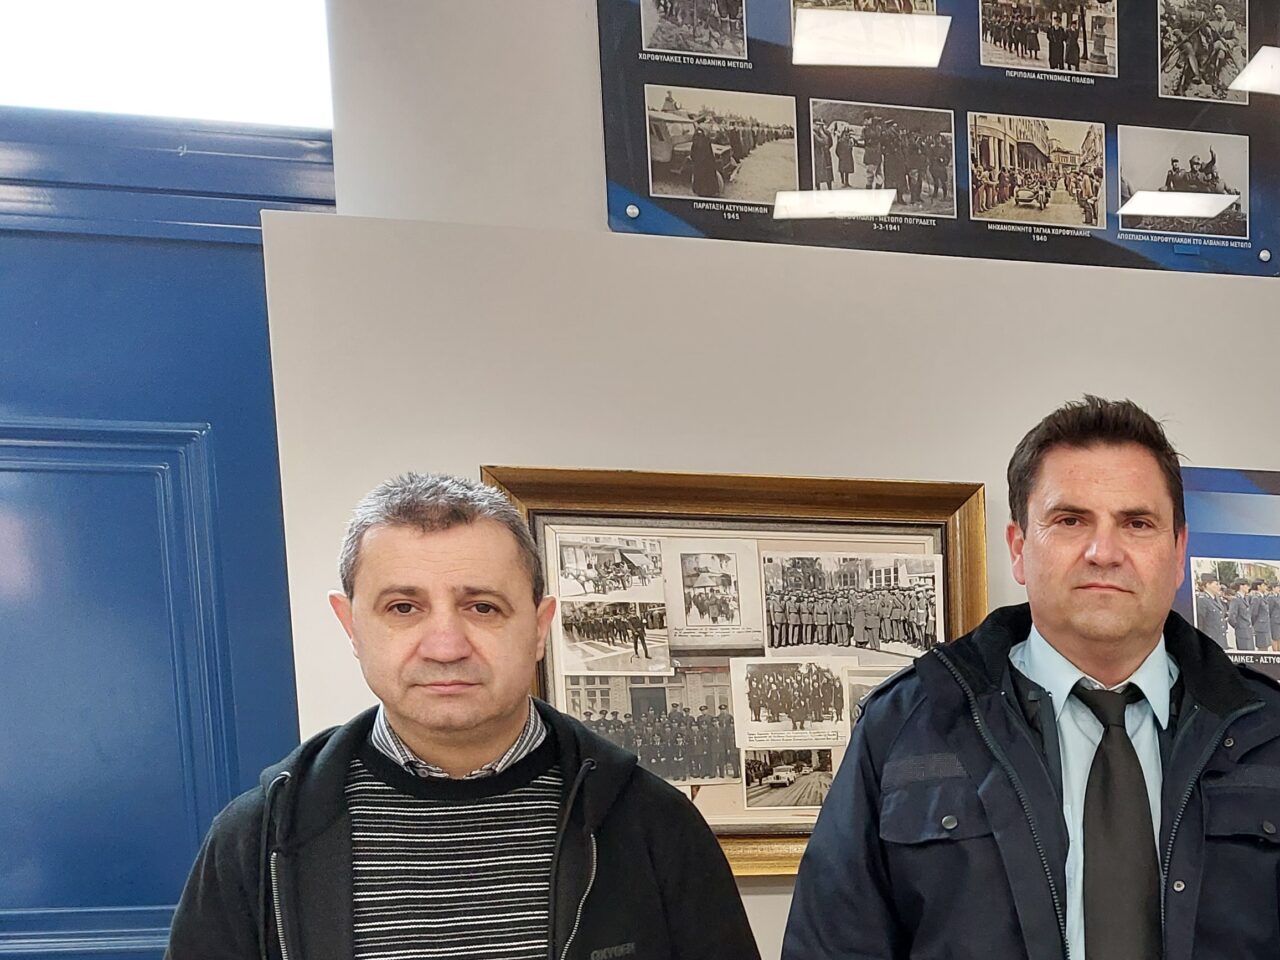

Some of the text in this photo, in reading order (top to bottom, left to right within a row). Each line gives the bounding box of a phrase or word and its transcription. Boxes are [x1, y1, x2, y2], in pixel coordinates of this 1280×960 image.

[683, 56, 694, 64] ΣΤΟ
[693, 202, 724, 211] ΠΑΡΑΤΑΞΗ
[873, 223, 900, 231] 3-3-1941
[1228, 655, 1255, 663] ΝΑΙΚΕΣ
